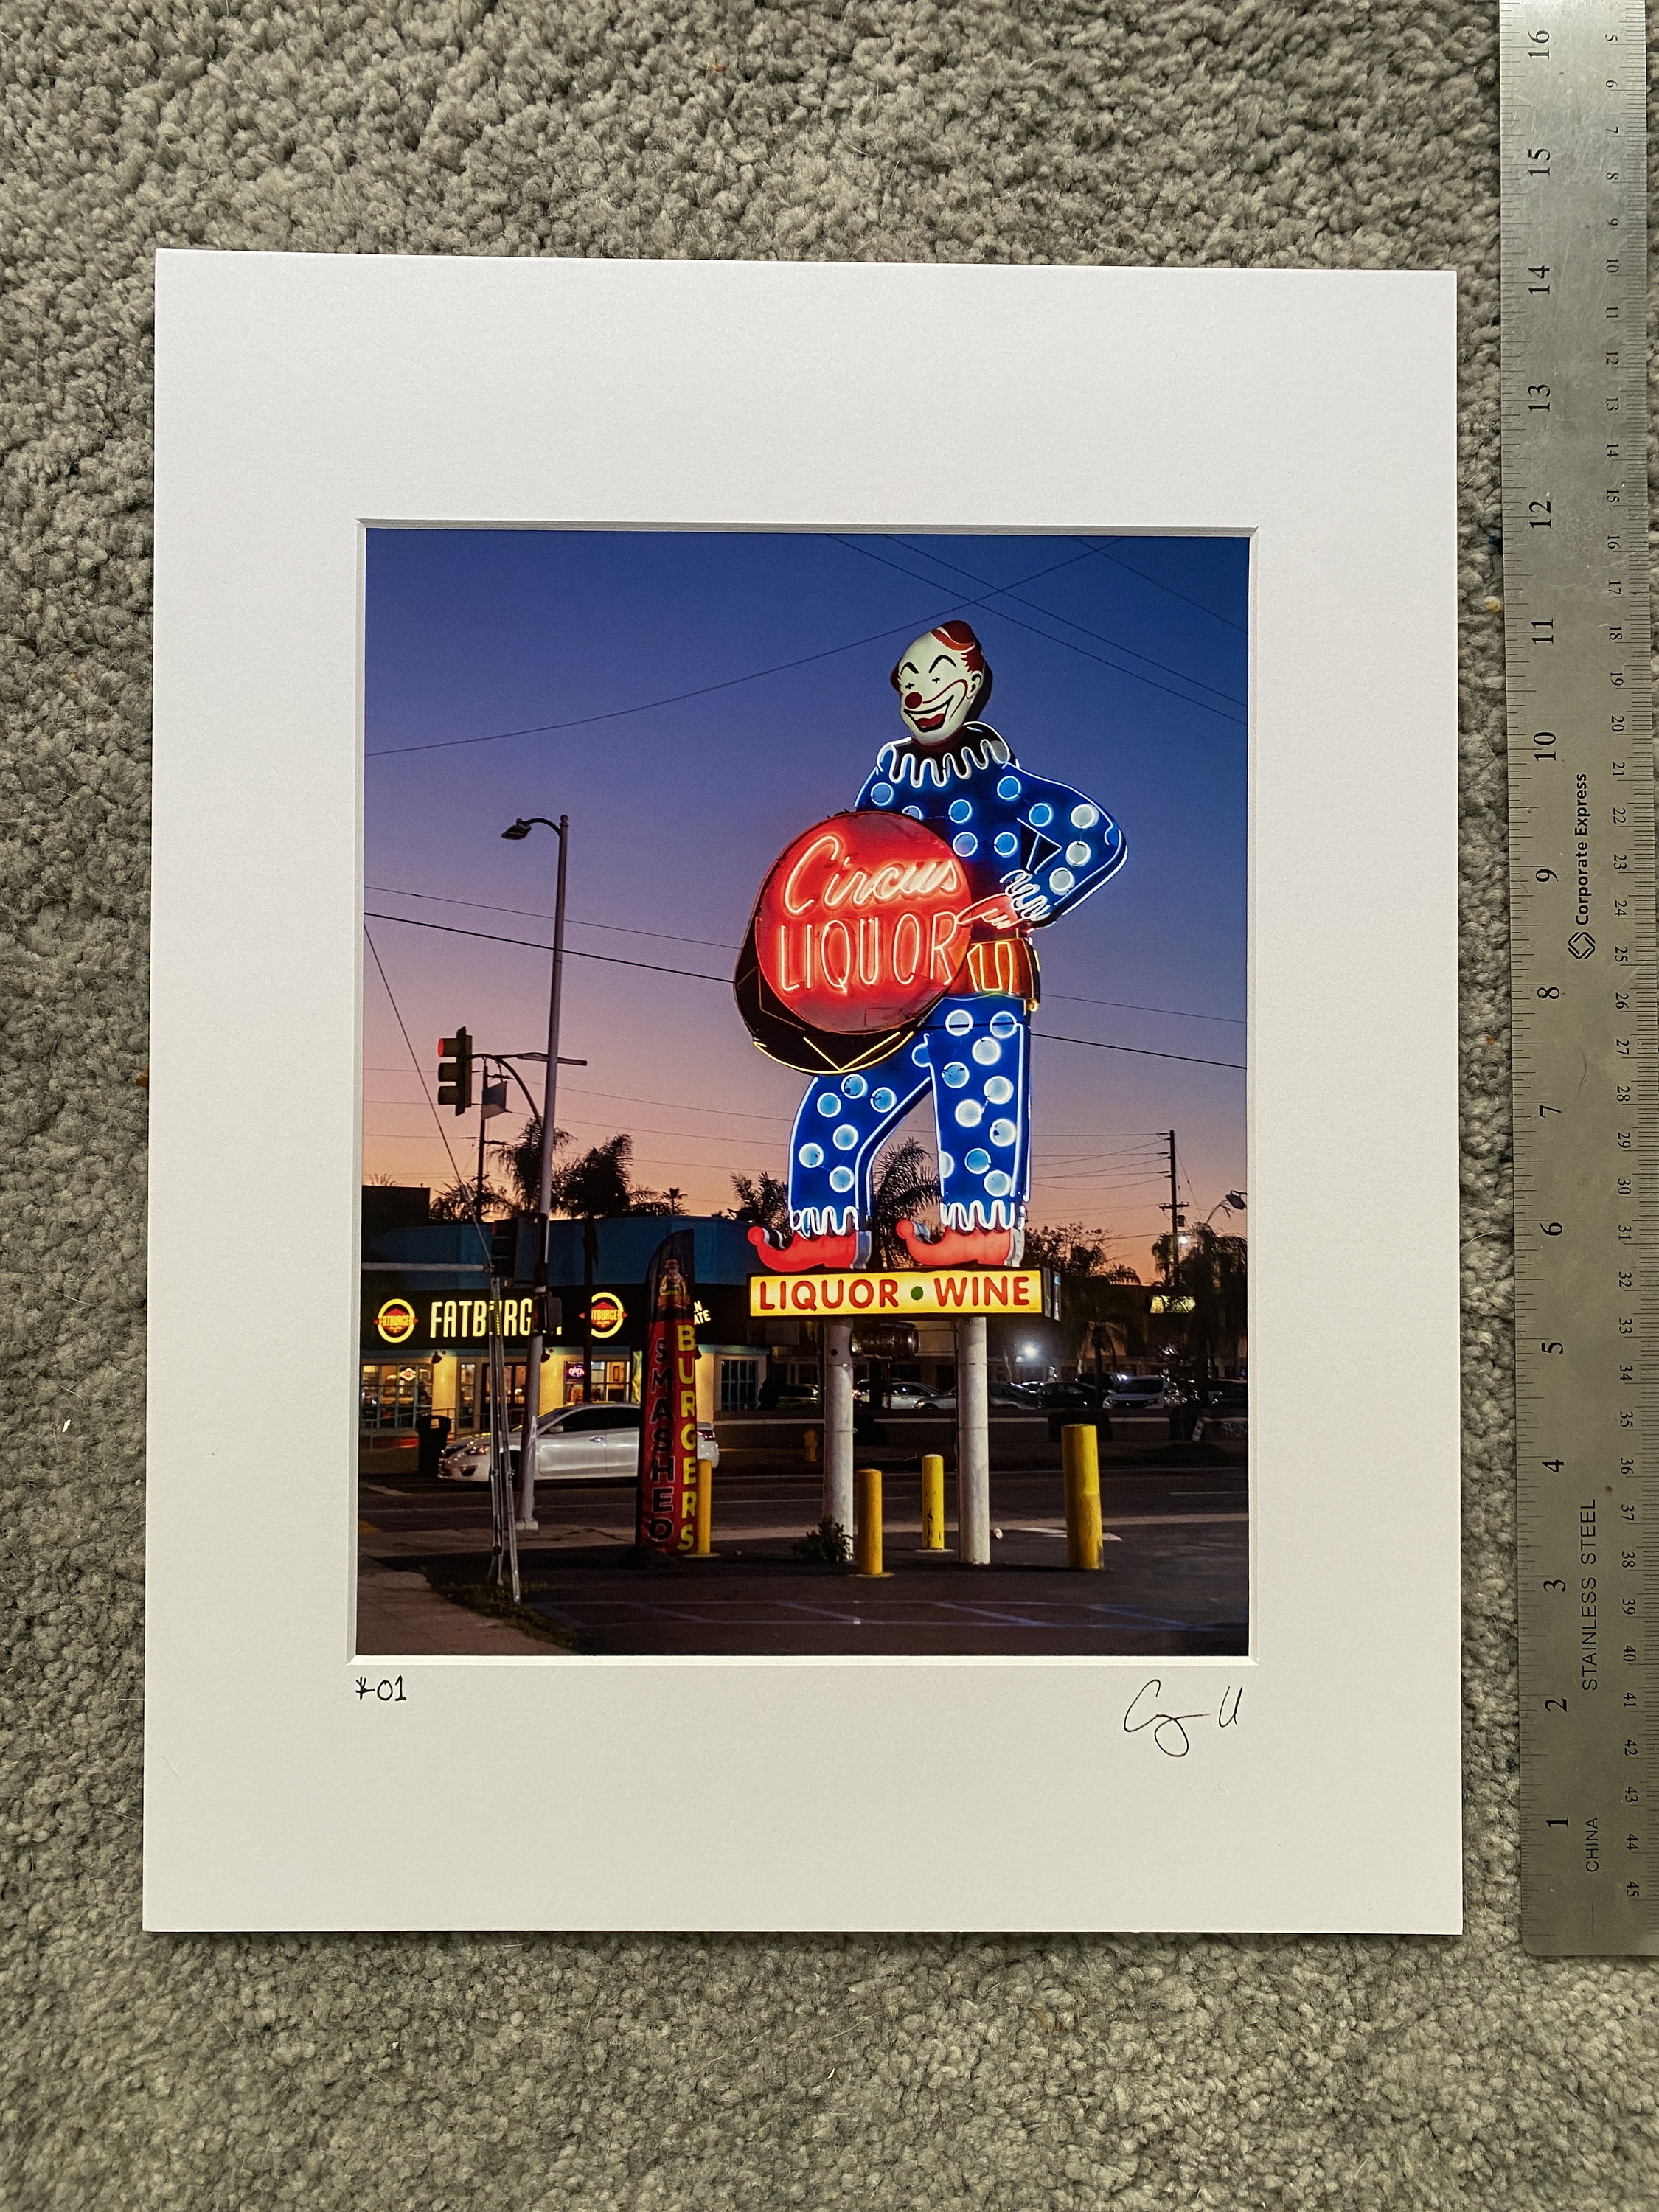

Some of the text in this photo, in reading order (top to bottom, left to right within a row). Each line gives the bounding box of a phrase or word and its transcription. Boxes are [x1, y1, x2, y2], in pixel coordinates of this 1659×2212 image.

[1527, 30, 1550, 60] 16
[1528, 148, 1551, 176] 15
[1605, 172, 1618, 181] 8
[1607, 218, 1619, 226] 9
[1606, 259, 1619, 273] 10
[1528, 265, 1551, 295] 14
[1606, 306, 1619, 319] 11
[1605, 351, 1619, 365] 12
[1528, 384, 1551, 412] 13
[1605, 397, 1620, 411] 13
[1606, 443, 1619, 458] 14
[1607, 490, 1620, 503] 15
[1528, 500, 1552, 529] 12
[1607, 535, 1621, 549] 16
[1608, 581, 1622, 595] 17
[1531, 619, 1554, 645] 11
[1609, 627, 1623, 640] 18
[1610, 672, 1624, 686] 19
[1611, 715, 1625, 732] 20
[1533, 731, 1557, 762] 10
[1612, 761, 1626, 776] 21
[1613, 807, 1627, 824] 22
[1574, 773, 1592, 926] Corporate Express
[1613, 853, 1627, 870] 23
[784, 834, 959, 916] Circus
[1535, 869, 1559, 883] 9
[1614, 900, 1628, 917] 24
[779, 910, 961, 994] LIQUOR
[1615, 946, 1628, 962] 25
[1537, 987, 1560, 1000] 8
[1615, 992, 1630, 1009] 26
[1615, 1038, 1630, 1056] 27
[1616, 1085, 1630, 1102] 28
[1539, 1105, 1562, 1119] 7
[1617, 1132, 1631, 1149] 29
[1617, 1178, 1632, 1195] 30
[1540, 1222, 1563, 1237] 6
[1618, 1224, 1632, 1239] 31
[1618, 1271, 1632, 1288] 32
[759, 1276, 1030, 1312] LIQUOR WINE
[429, 1299, 563, 1339] FATBRG
[1618, 1318, 1632, 1334] 33
[1541, 1342, 1564, 1354] 5
[1619, 1364, 1633, 1381] 34
[1619, 1411, 1634, 1427] 35
[648, 1337, 676, 1542] SMASHED
[676, 1324, 698, 1551] BURGERS
[1541, 1459, 1565, 1473] 4
[1620, 1458, 1634, 1475] 36
[1621, 1504, 1635, 1521] 37
[1621, 1551, 1635, 1568] 38
[1543, 1579, 1566, 1593] 3
[1580, 1498, 1599, 1691] STAINLESS STEEL
[1622, 1598, 1636, 1615] 39
[1623, 1645, 1637, 1662] 40
[1544, 1697, 1568, 1712] 2
[1624, 1692, 1637, 1707] 41
[1624, 1739, 1638, 1756] 42
[1624, 1787, 1638, 1803] 43
[1545, 1818, 1569, 1829] 1
[1585, 1817, 1599, 1873] CHINA
[1626, 1834, 1639, 1851] 44
[1626, 1881, 1640, 1897] 45
